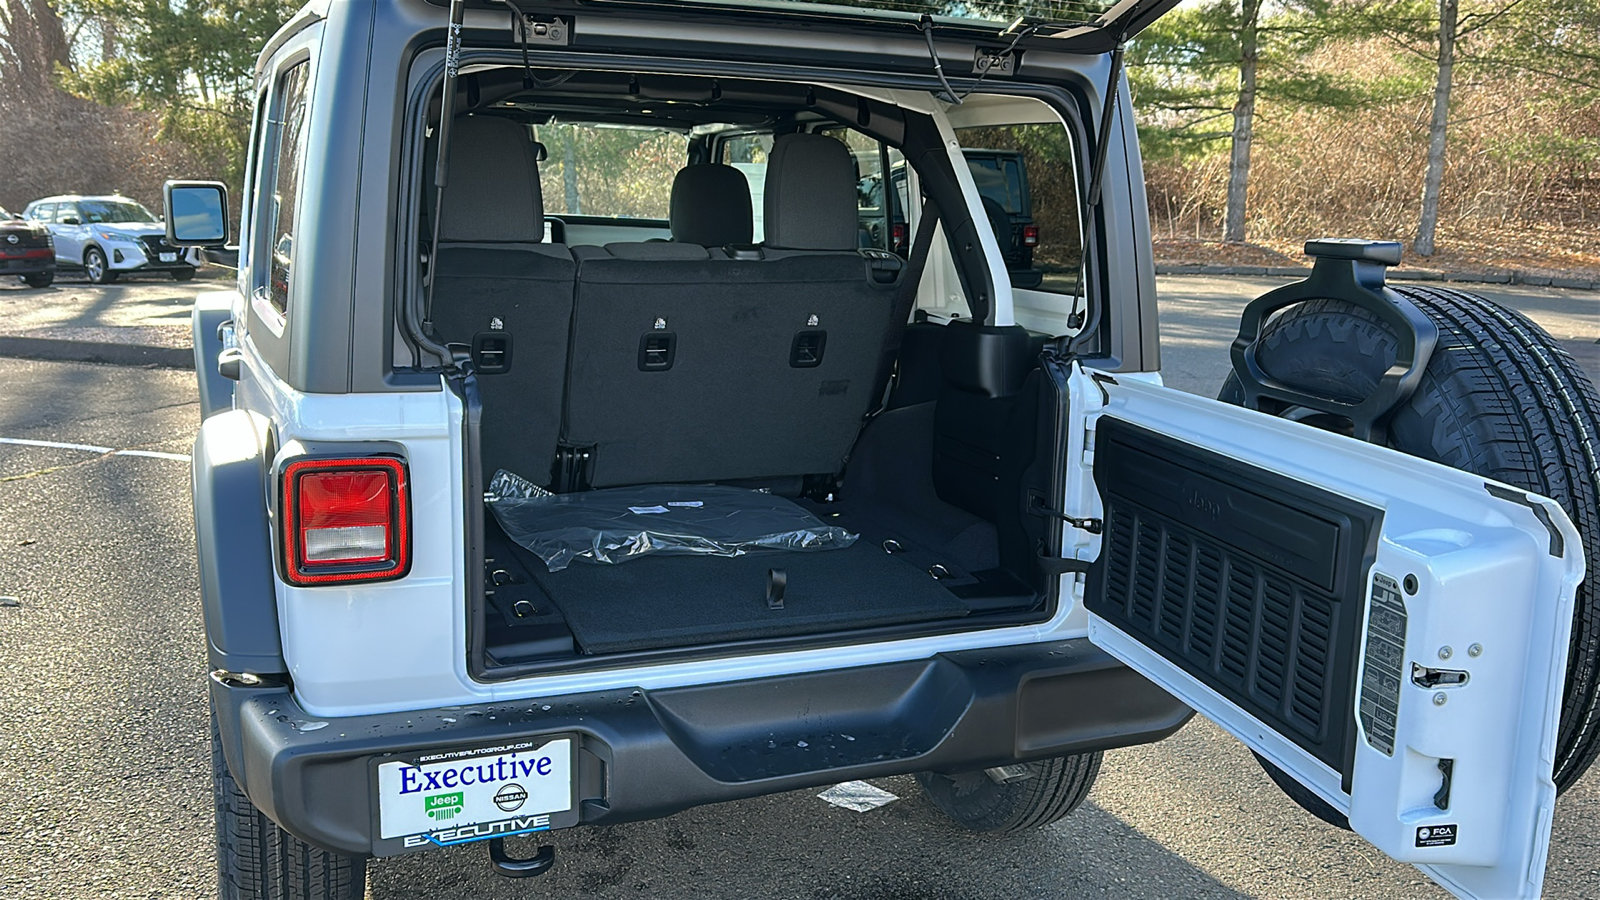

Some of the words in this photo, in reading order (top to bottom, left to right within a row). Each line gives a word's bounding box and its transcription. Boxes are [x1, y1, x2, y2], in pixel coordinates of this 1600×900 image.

[1379, 577, 1392, 587] Jeep
[1372, 590, 1403, 607] JL
[1376, 711, 1394, 726] USA
[419, 742, 533, 762] EXECUTIVEAUTOGROUP.COM
[399, 753, 552, 794] Executive
[430, 794, 459, 806] Jeep
[495, 793, 526, 803] NISSAN
[403, 814, 550, 848] EXECUTIVE
[1433, 827, 1452, 835] FCA
